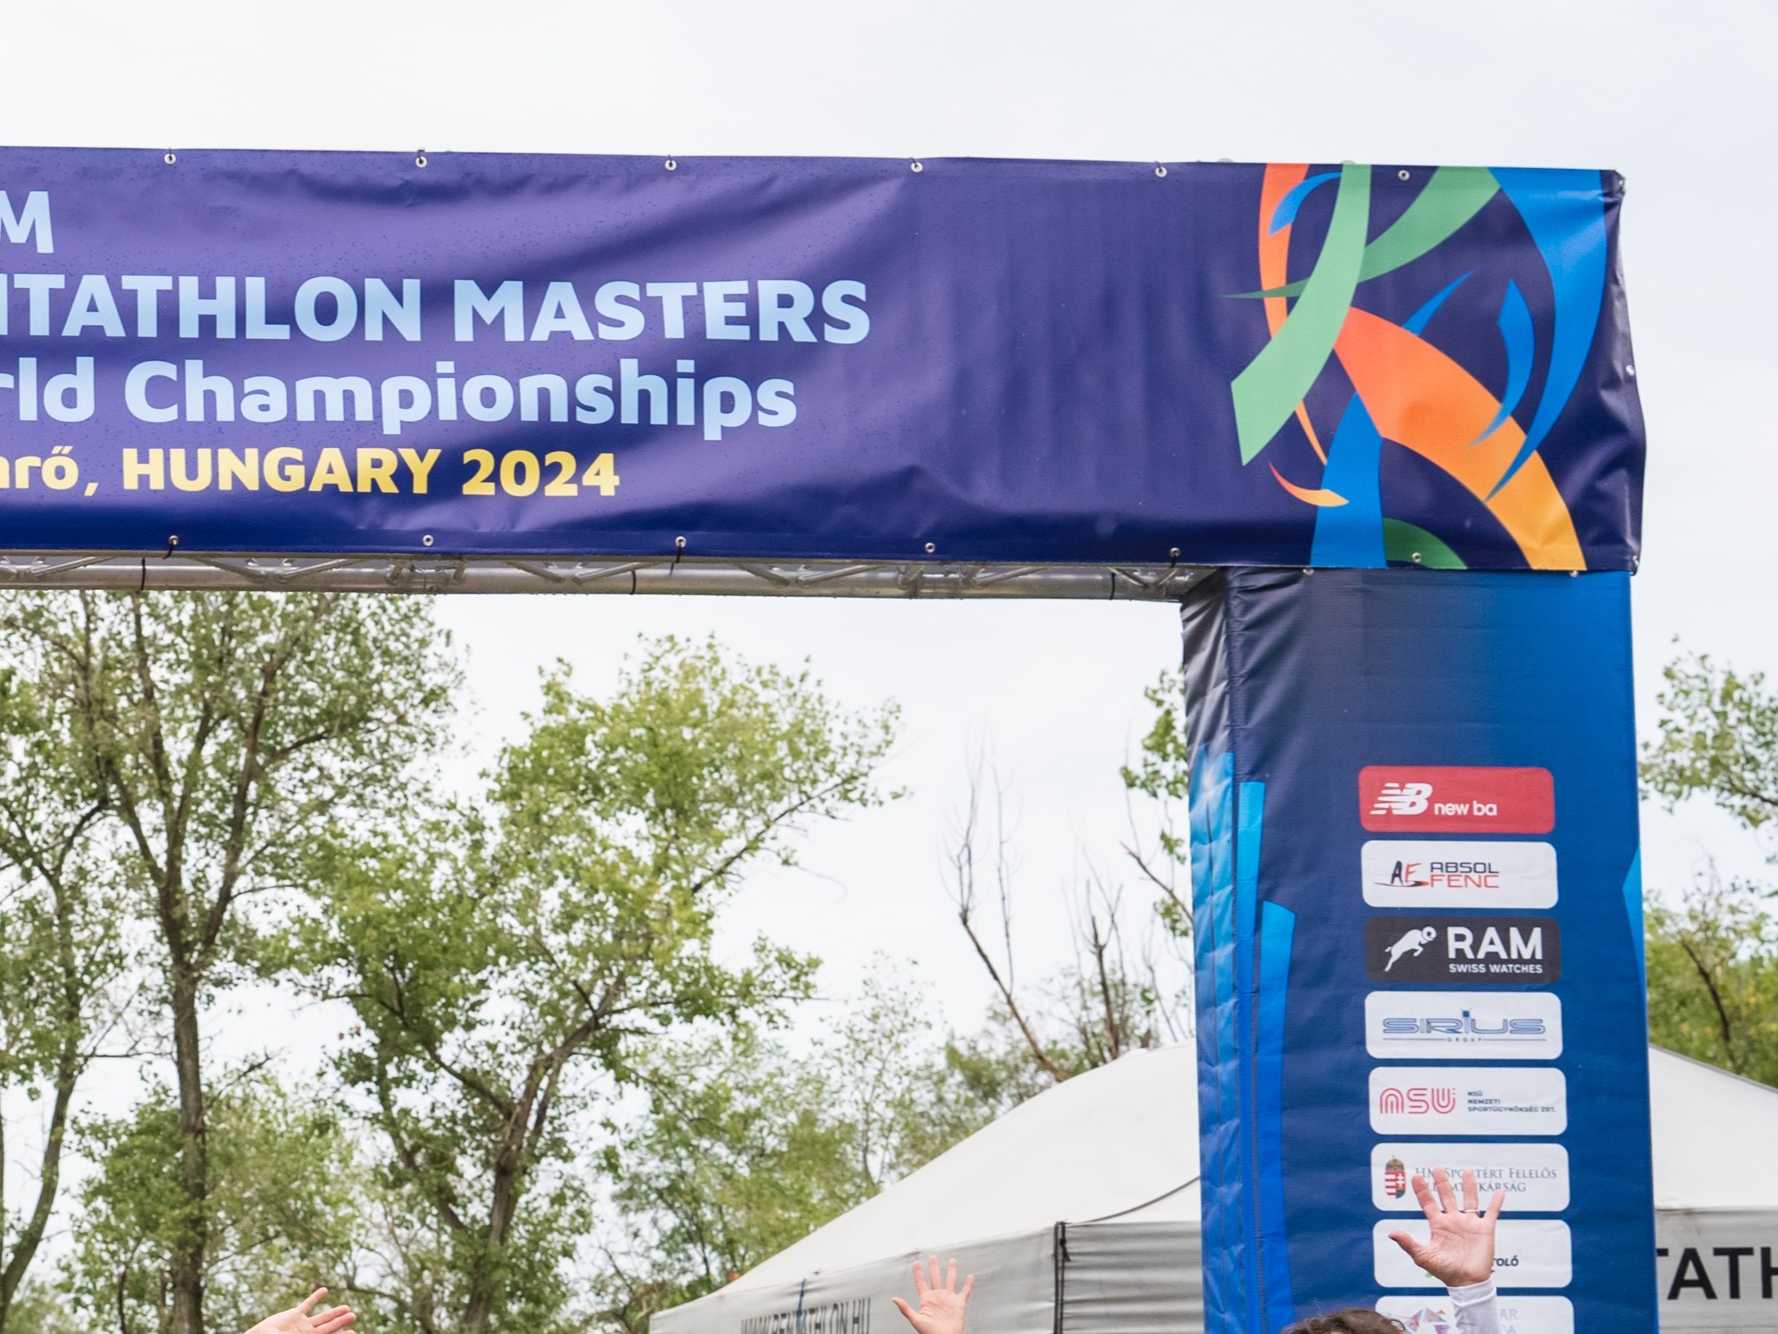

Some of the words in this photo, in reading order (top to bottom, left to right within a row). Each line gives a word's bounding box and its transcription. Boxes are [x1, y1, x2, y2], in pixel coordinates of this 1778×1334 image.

[454, 279, 870, 345] MASTERS
[125, 358, 797, 440] Championships
[123, 445, 442, 495] HUNGARY
[462, 449, 620, 497] 2024
[1434, 802, 1469, 816] new
[1473, 801, 1497, 816] ba
[1430, 862, 1500, 873] ABSOL
[1430, 875, 1500, 888] FENC
[1447, 926, 1543, 960] RAM
[1449, 963, 1486, 974] SWISS
[1490, 964, 1543, 974] WATCHES
